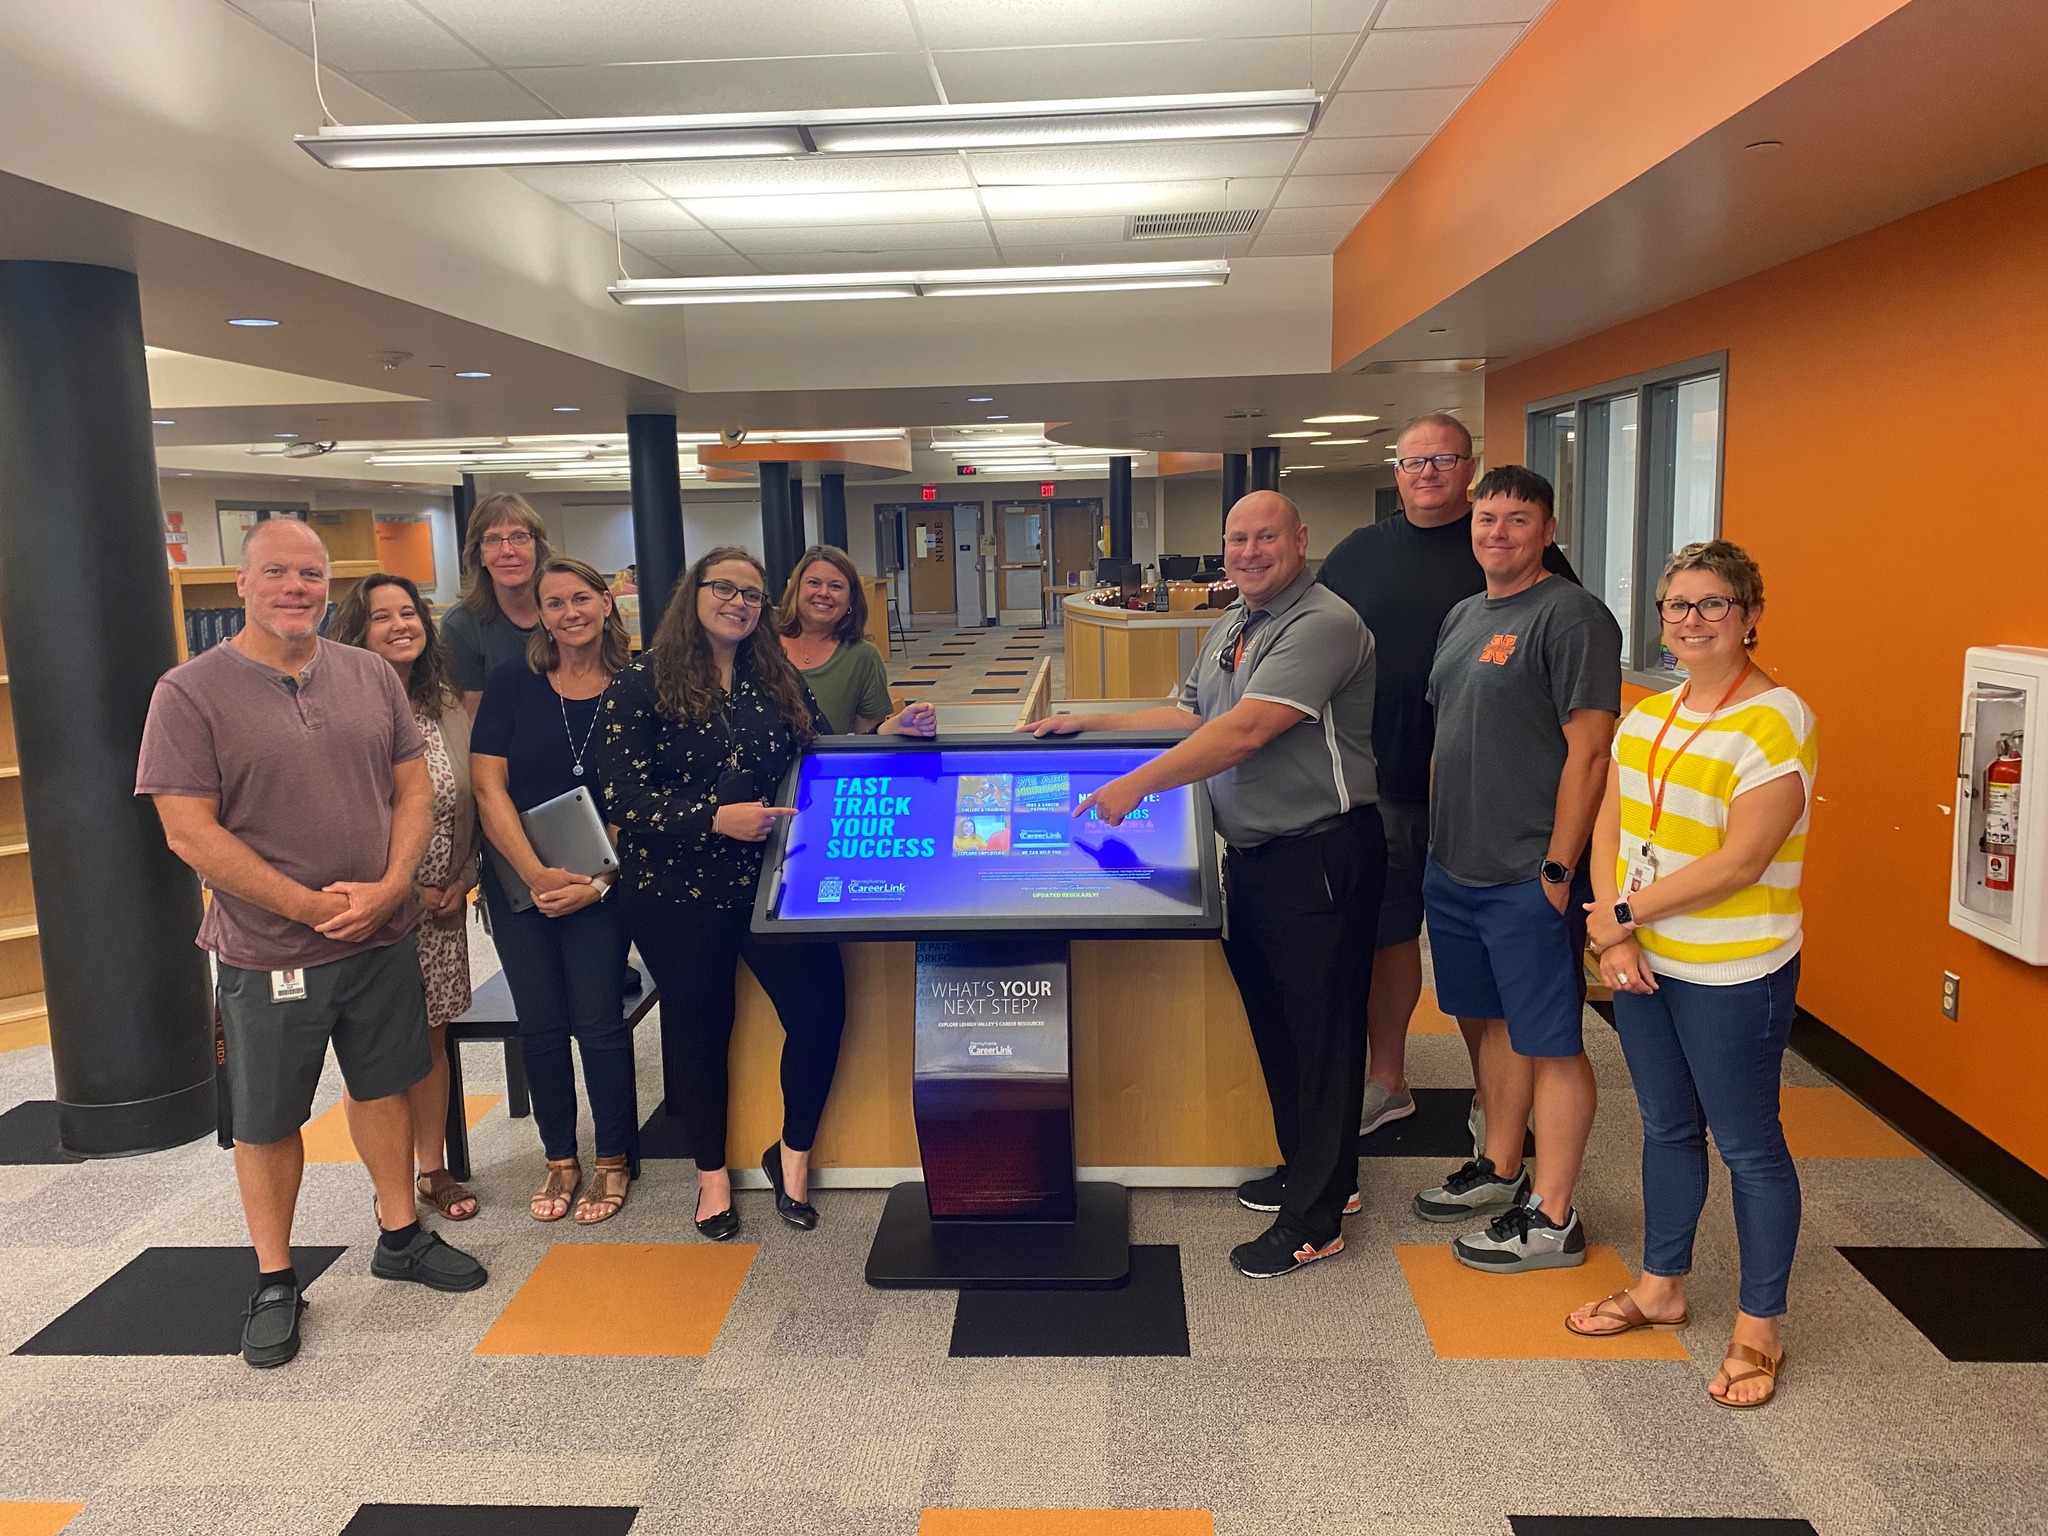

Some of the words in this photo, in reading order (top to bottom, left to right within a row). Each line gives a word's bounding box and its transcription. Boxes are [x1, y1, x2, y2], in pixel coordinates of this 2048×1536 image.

[922, 489, 937, 500] EXIT
[1041, 485, 1055, 497] EXIT
[934, 521, 944, 563] NURSE
[835, 777, 892, 796] FAST
[1015, 782, 1069, 797] HIRING
[833, 797, 912, 816] TRACK
[830, 817, 895, 837] YOUR
[826, 837, 936, 859] SUCCESS
[849, 883, 906, 893] CareerLink
[931, 981, 995, 998] WHAT'S
[1000, 981, 1052, 997] YOUR
[944, 999, 986, 1015] NEXT
[991, 999, 1038, 1015] STEP?
[216, 1040, 226, 1065] KIDS
[970, 1046, 1013, 1055] CareerLink
